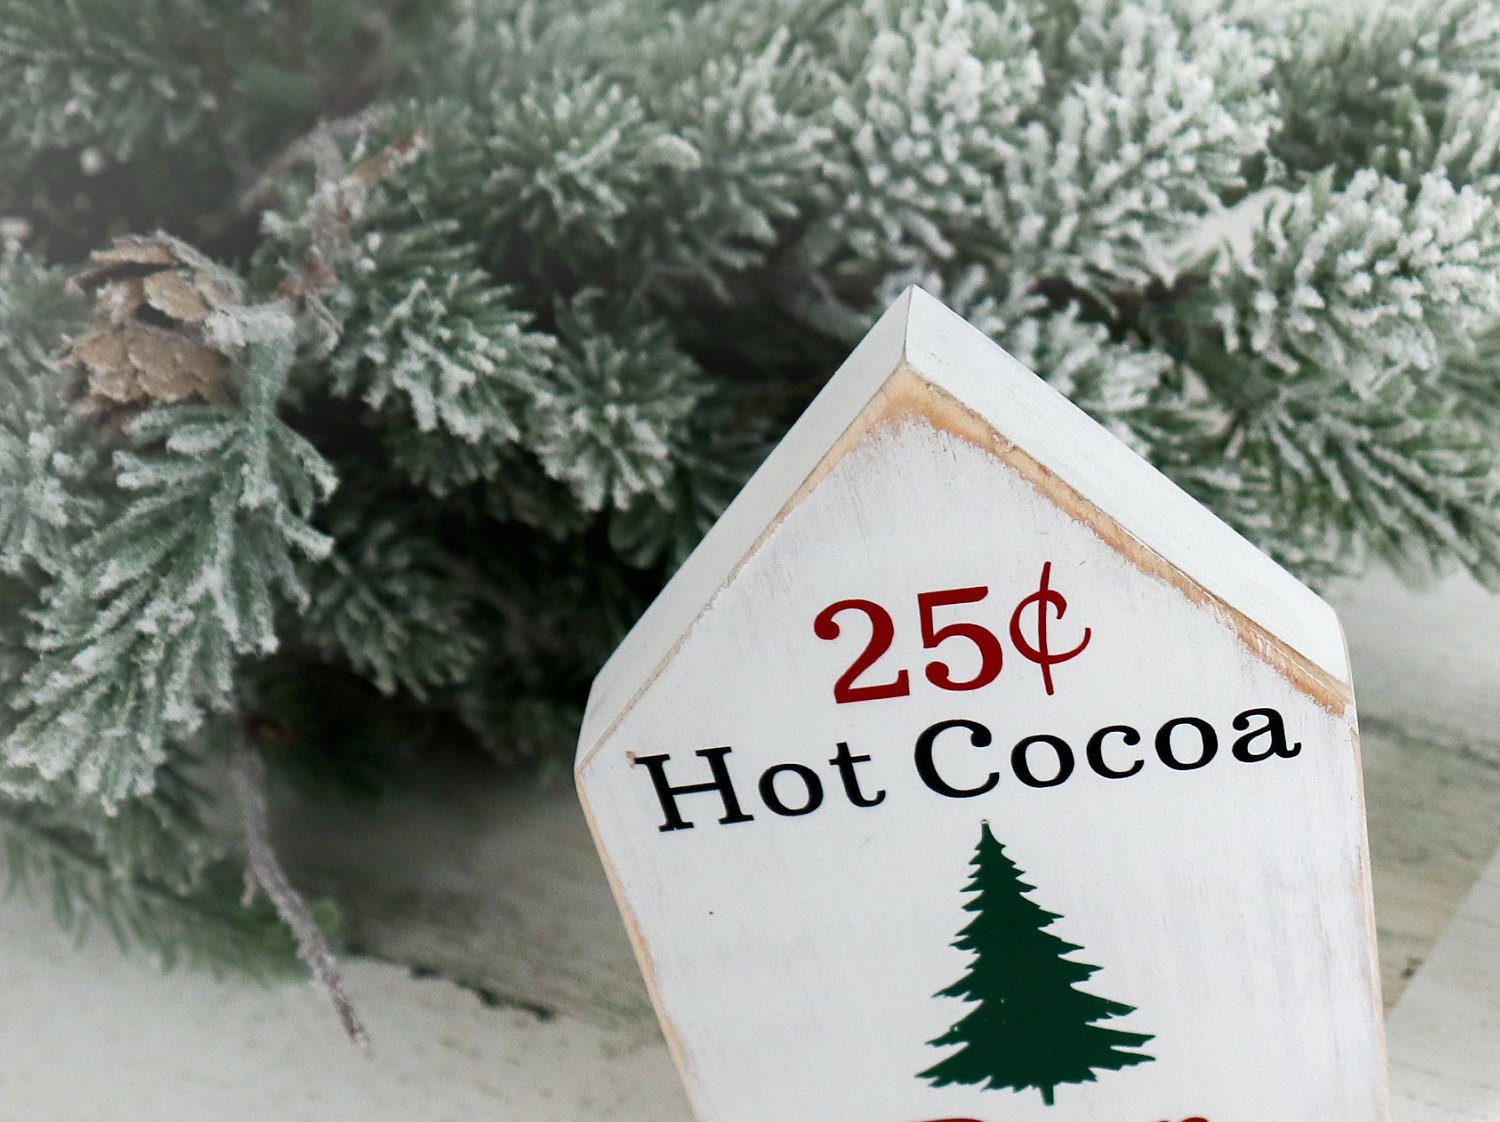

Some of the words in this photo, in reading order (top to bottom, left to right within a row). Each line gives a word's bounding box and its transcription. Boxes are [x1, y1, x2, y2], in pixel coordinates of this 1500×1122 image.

[813, 561, 1092, 705] 25¢
[633, 741, 888, 833] Hot
[913, 707, 1303, 799] Cocoa
